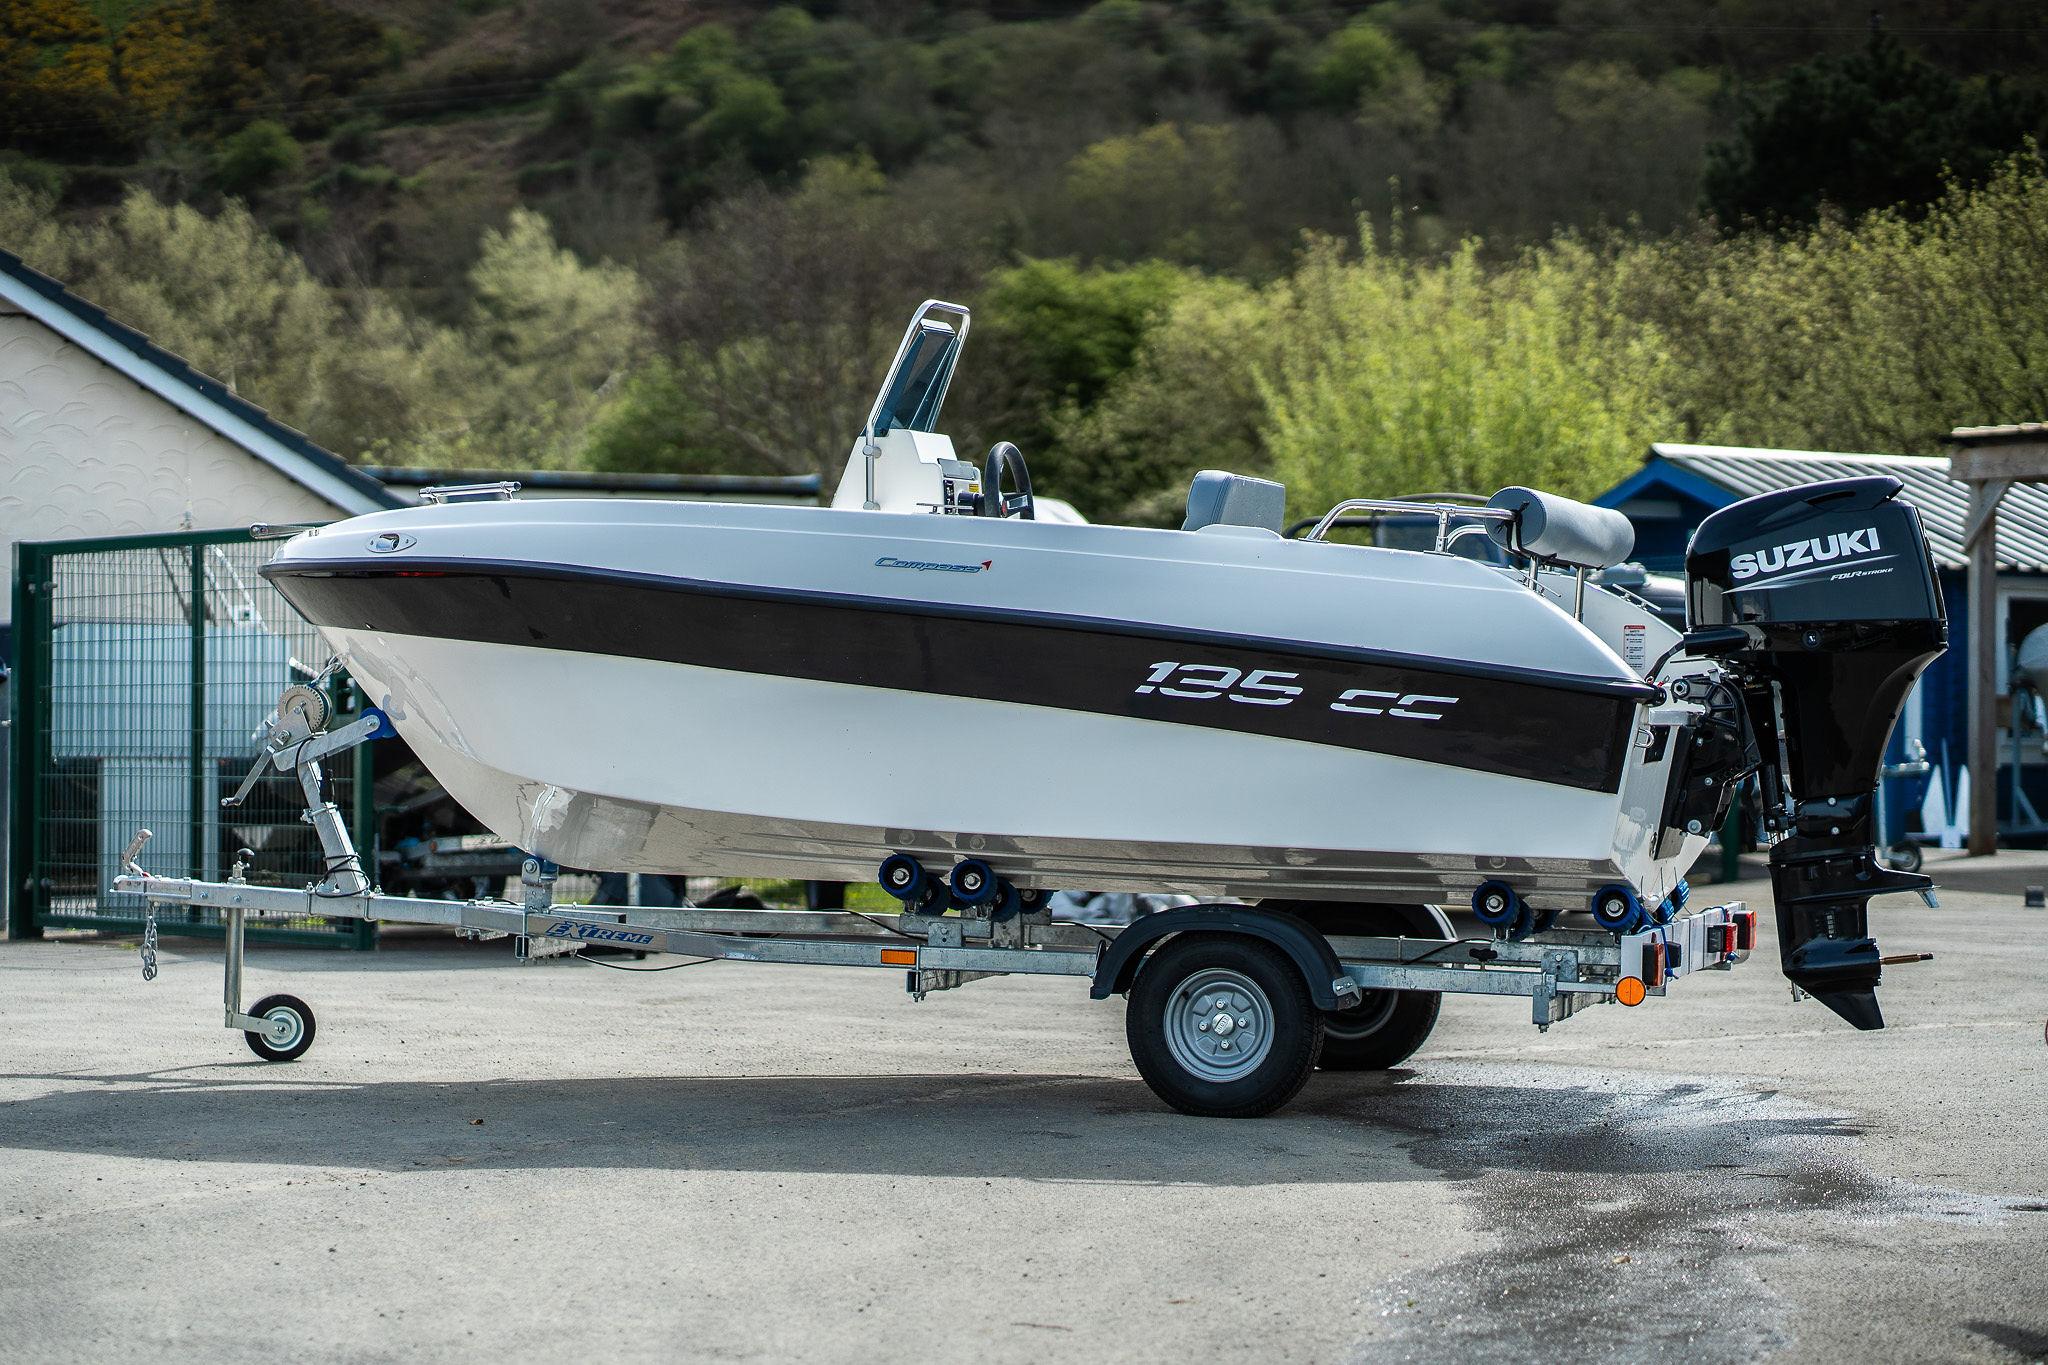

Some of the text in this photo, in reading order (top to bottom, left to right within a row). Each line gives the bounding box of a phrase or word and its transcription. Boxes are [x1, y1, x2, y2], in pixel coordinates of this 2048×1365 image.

[874, 556, 983, 574] Compass
[1730, 527, 1881, 579] SUZUKI
[1830, 570, 1862, 581] FOUR
[1134, 661, 1304, 706] 135
[545, 920, 655, 945] EXTREME
